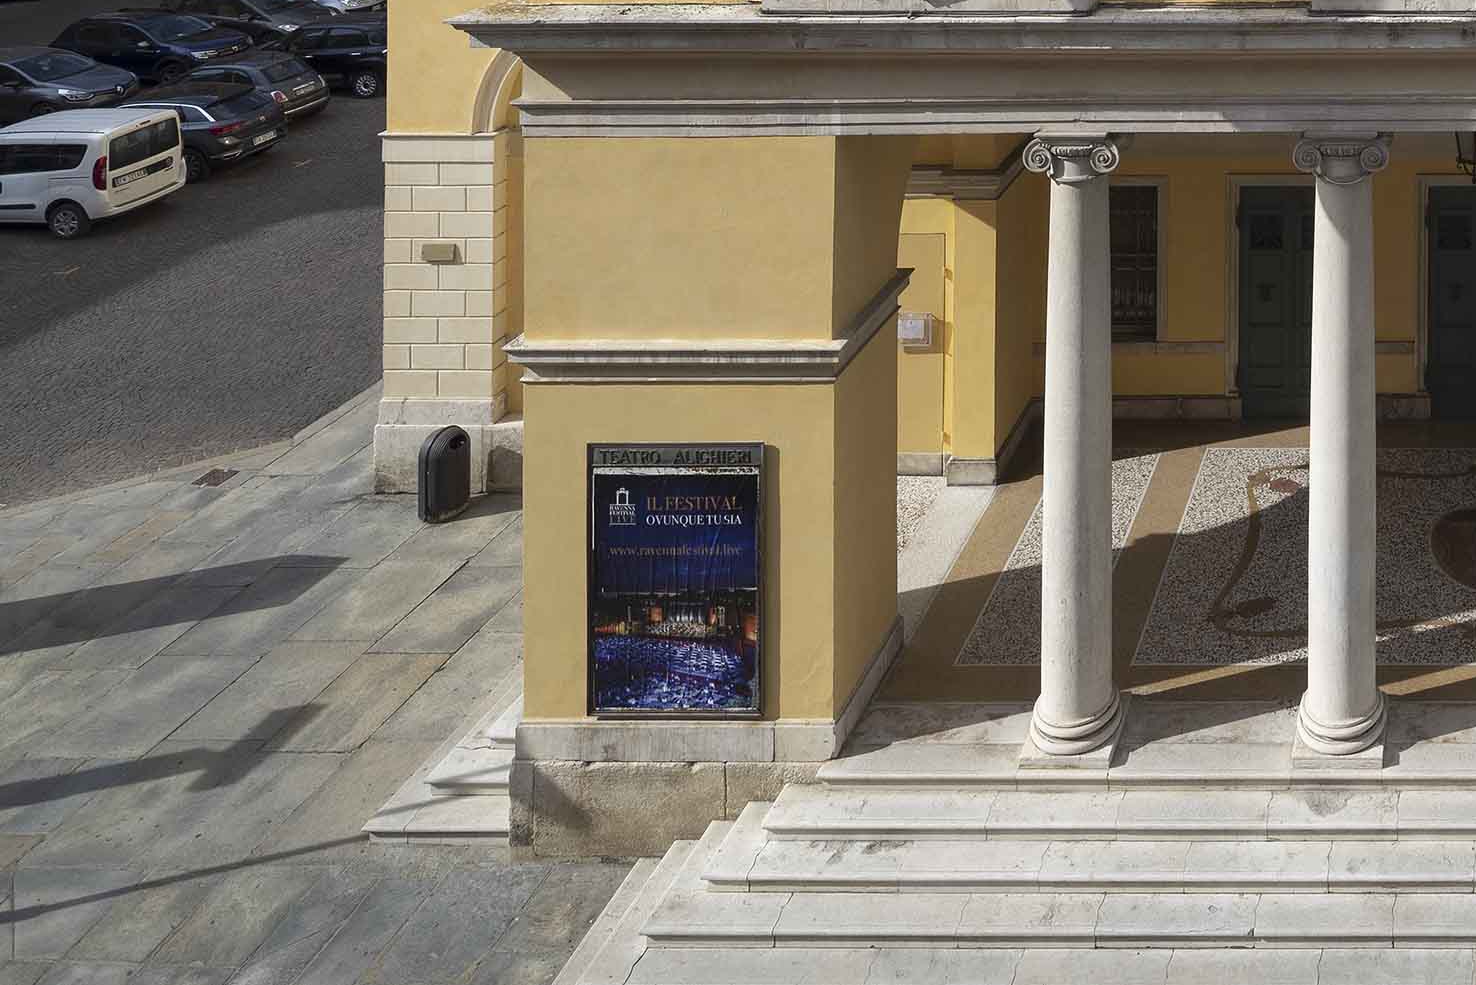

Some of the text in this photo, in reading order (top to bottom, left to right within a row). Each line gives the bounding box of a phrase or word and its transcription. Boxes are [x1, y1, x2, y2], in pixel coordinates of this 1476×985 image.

[599, 450, 752, 465] TEATRO ALIGHIERI
[647, 495, 743, 511] IL FESTIVAL
[646, 514, 742, 527] OVUNQUE TU SIA
